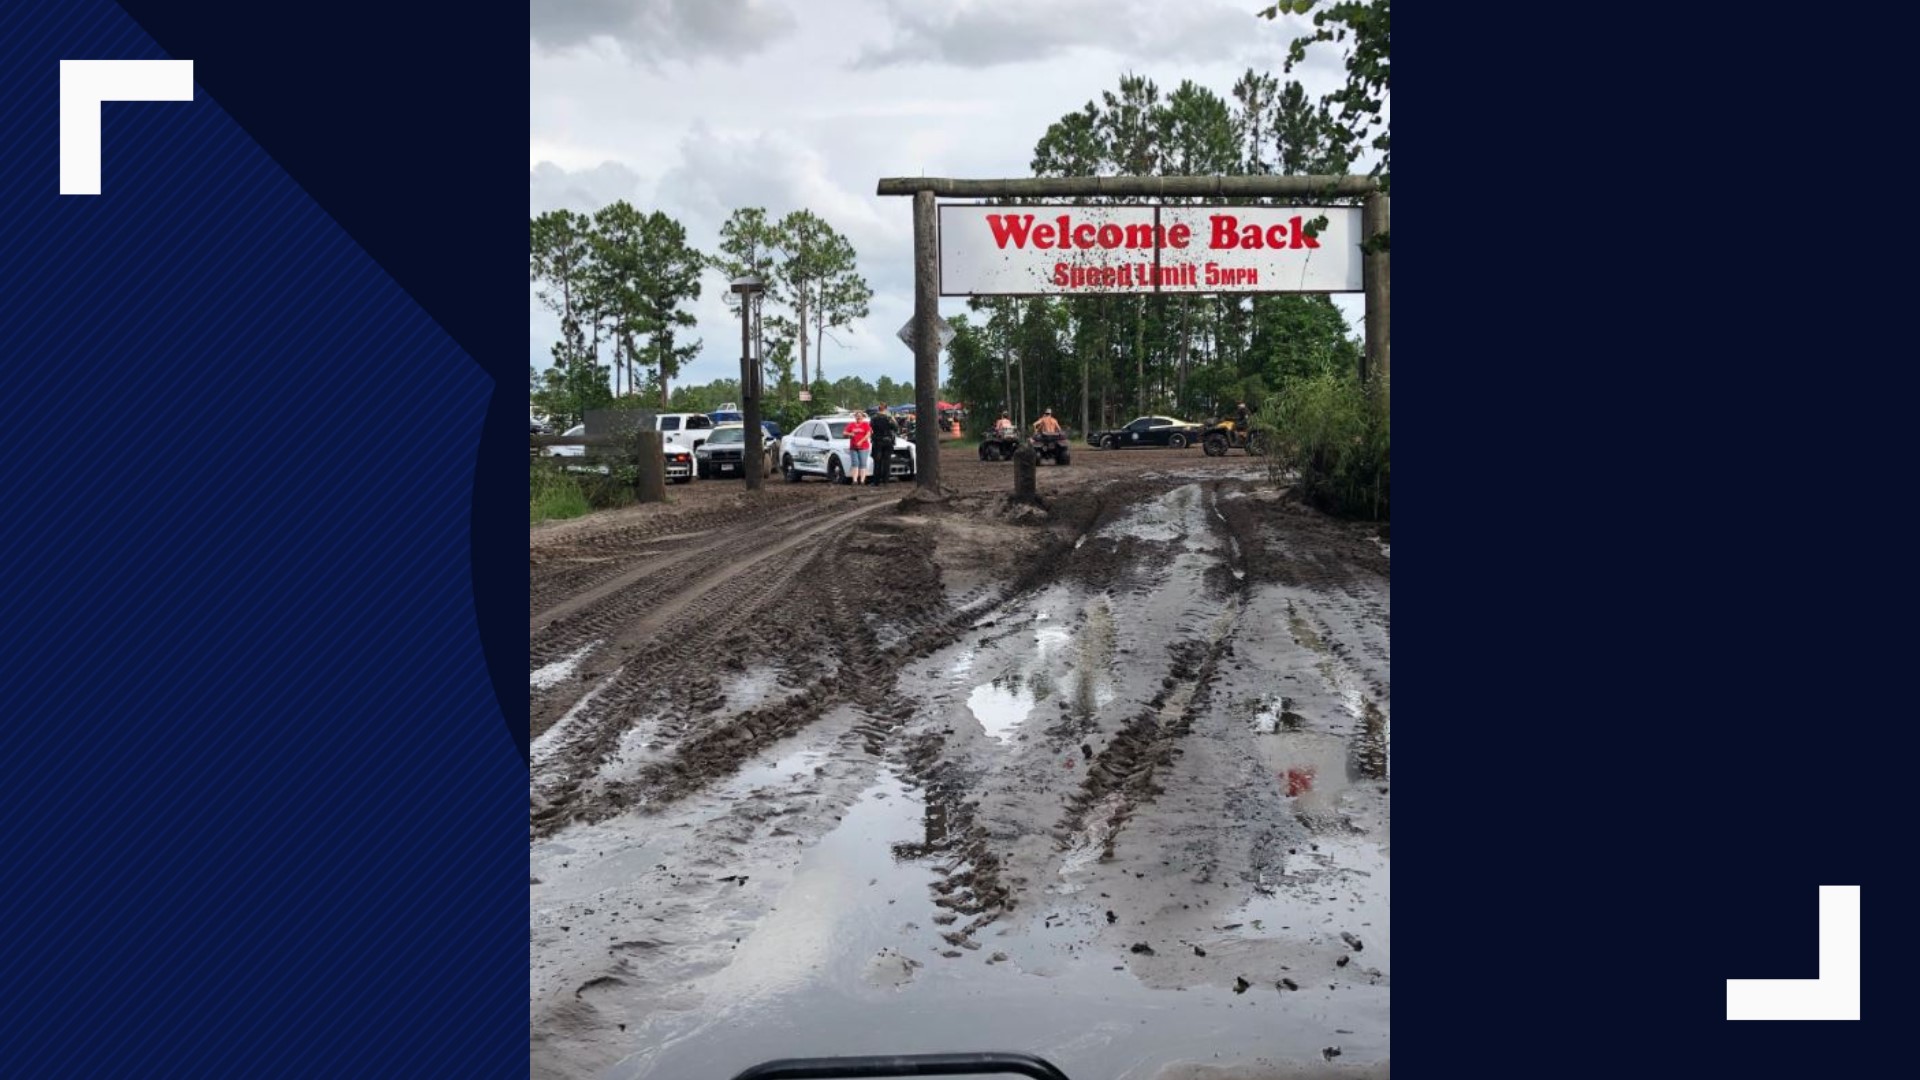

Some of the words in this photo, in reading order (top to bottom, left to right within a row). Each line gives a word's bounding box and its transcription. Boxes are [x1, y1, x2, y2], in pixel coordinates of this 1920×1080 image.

[986, 214, 1191, 249] Welcome
[1209, 214, 1321, 249] Back
[1054, 262, 1131, 288] Speed
[1137, 262, 1197, 286] Limit
